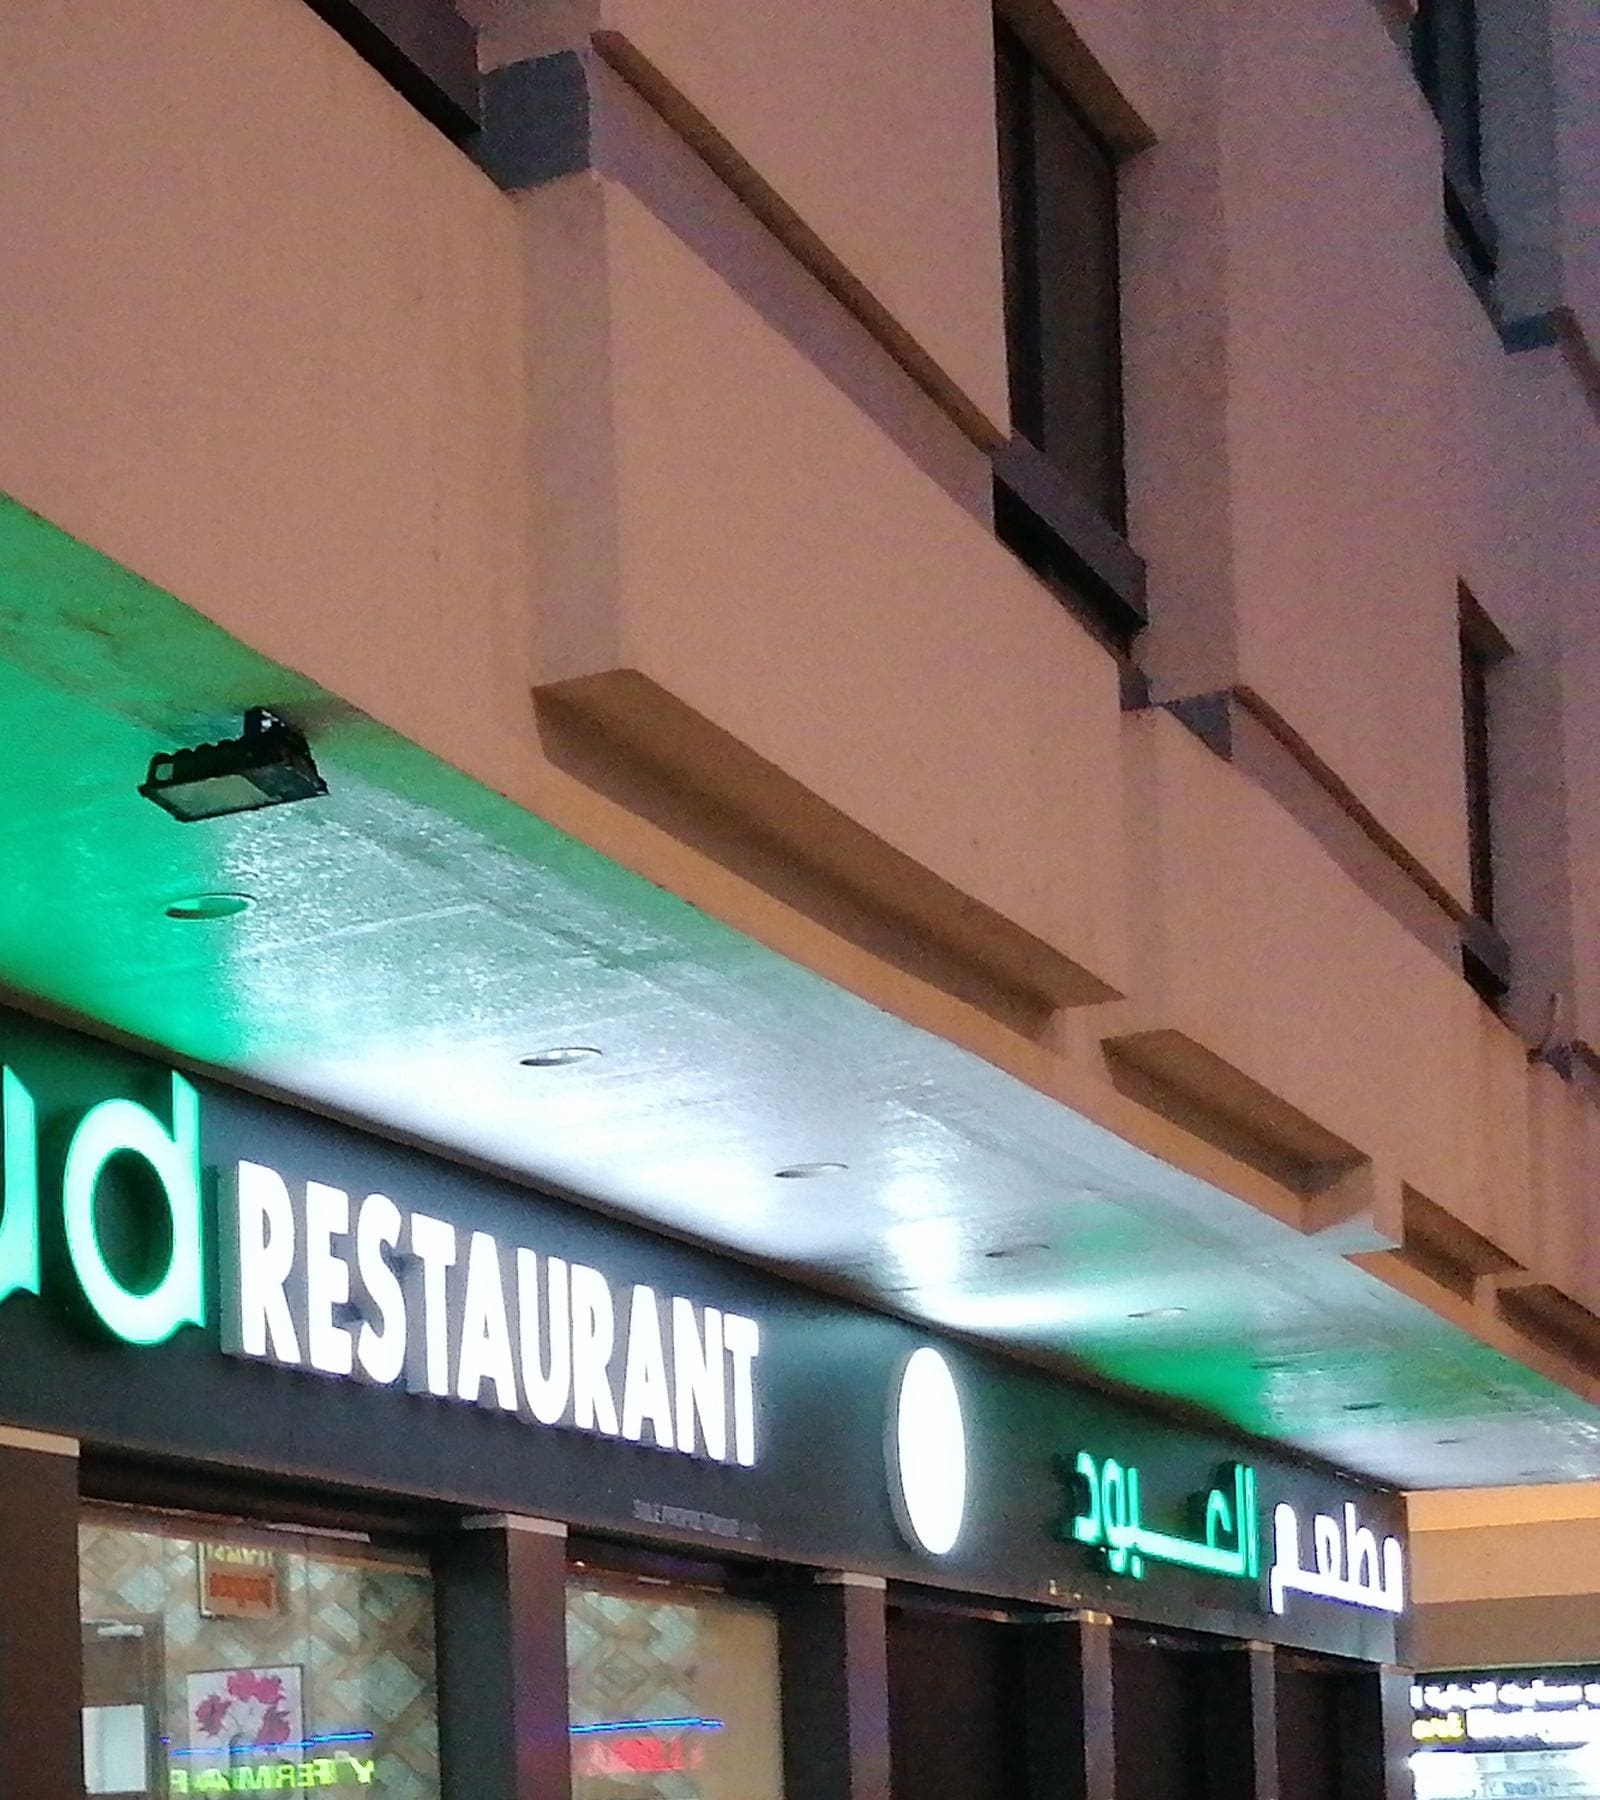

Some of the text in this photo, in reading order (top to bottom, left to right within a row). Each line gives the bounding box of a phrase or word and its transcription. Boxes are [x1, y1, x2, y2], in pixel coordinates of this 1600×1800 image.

[236, 1159, 760, 1467] RESTAURANT
[1072, 1450, 1404, 1615] مطعم العبود
